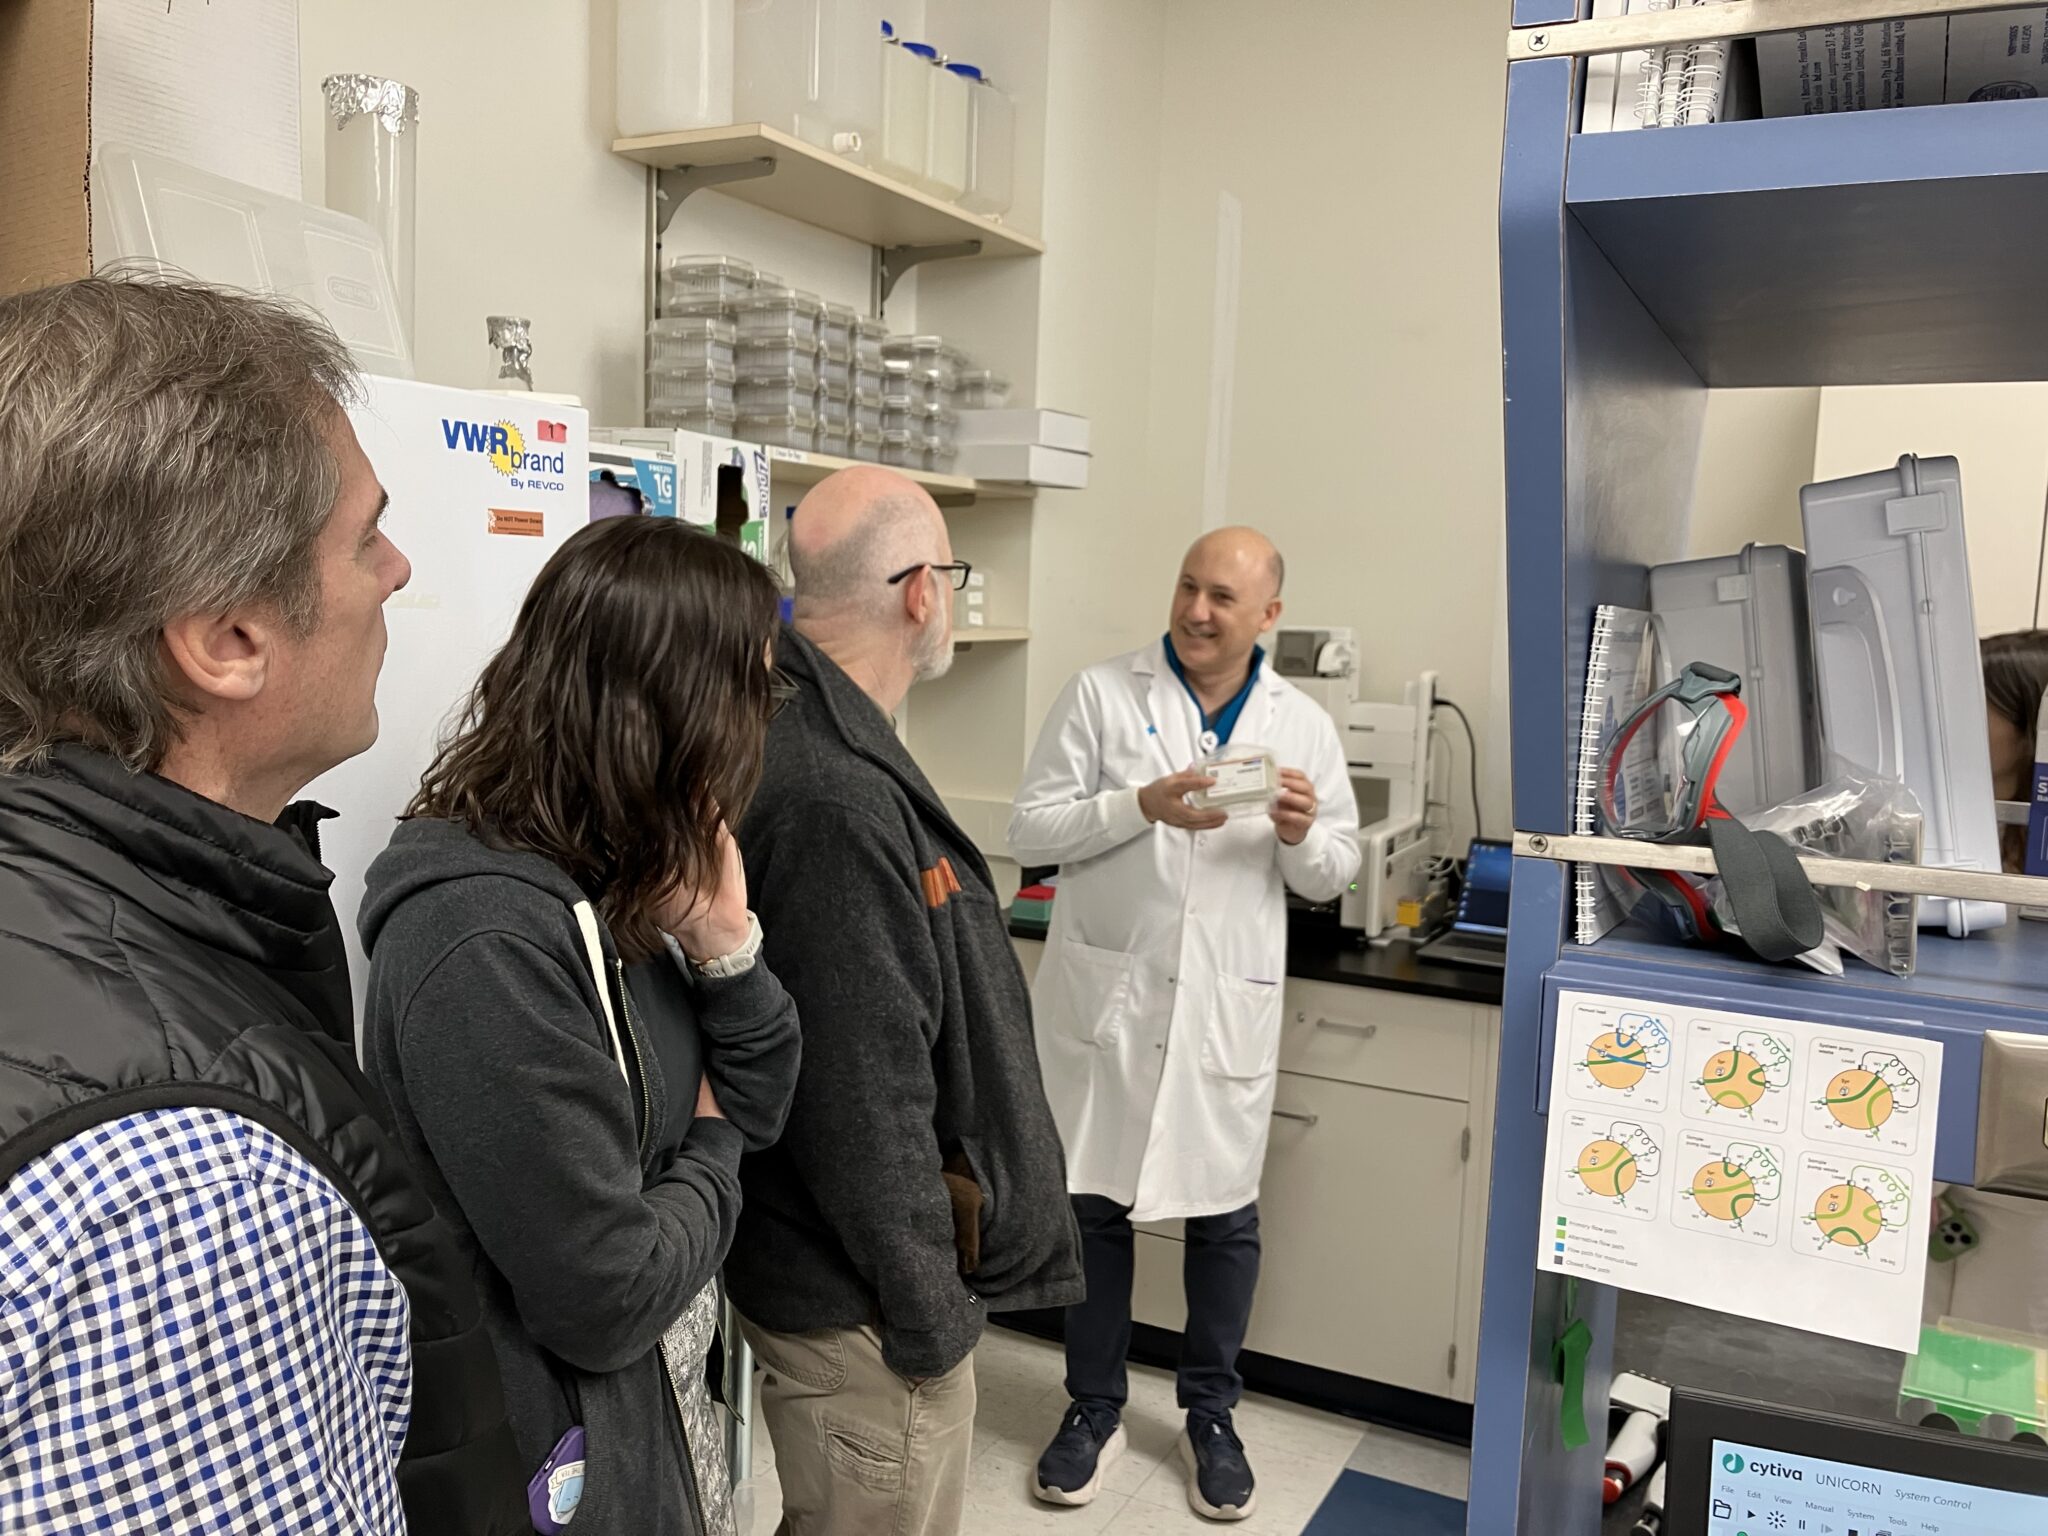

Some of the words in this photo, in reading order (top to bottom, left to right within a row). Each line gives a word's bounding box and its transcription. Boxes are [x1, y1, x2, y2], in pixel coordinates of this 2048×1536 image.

[442, 418, 509, 456] VWR
[511, 446, 564, 474] brand
[511, 478, 524, 489] By
[528, 480, 564, 491] REVCO
[653, 473, 672, 498] 1G
[754, 451, 769, 518] Ziploc
[1750, 1458, 1803, 1482] cytiva
[1816, 1473, 1882, 1495] UNICORN
[1895, 1488, 1931, 1505] System
[1933, 1493, 1972, 1510] Control
[1721, 1485, 1735, 1494] File
[1747, 1490, 1762, 1500] Edit
[1774, 1495, 1792, 1506] View
[1806, 1501, 1834, 1513] Manual
[1847, 1509, 1875, 1521] System
[1888, 1516, 1908, 1527] Tools
[1921, 1522, 1939, 1533] Help
